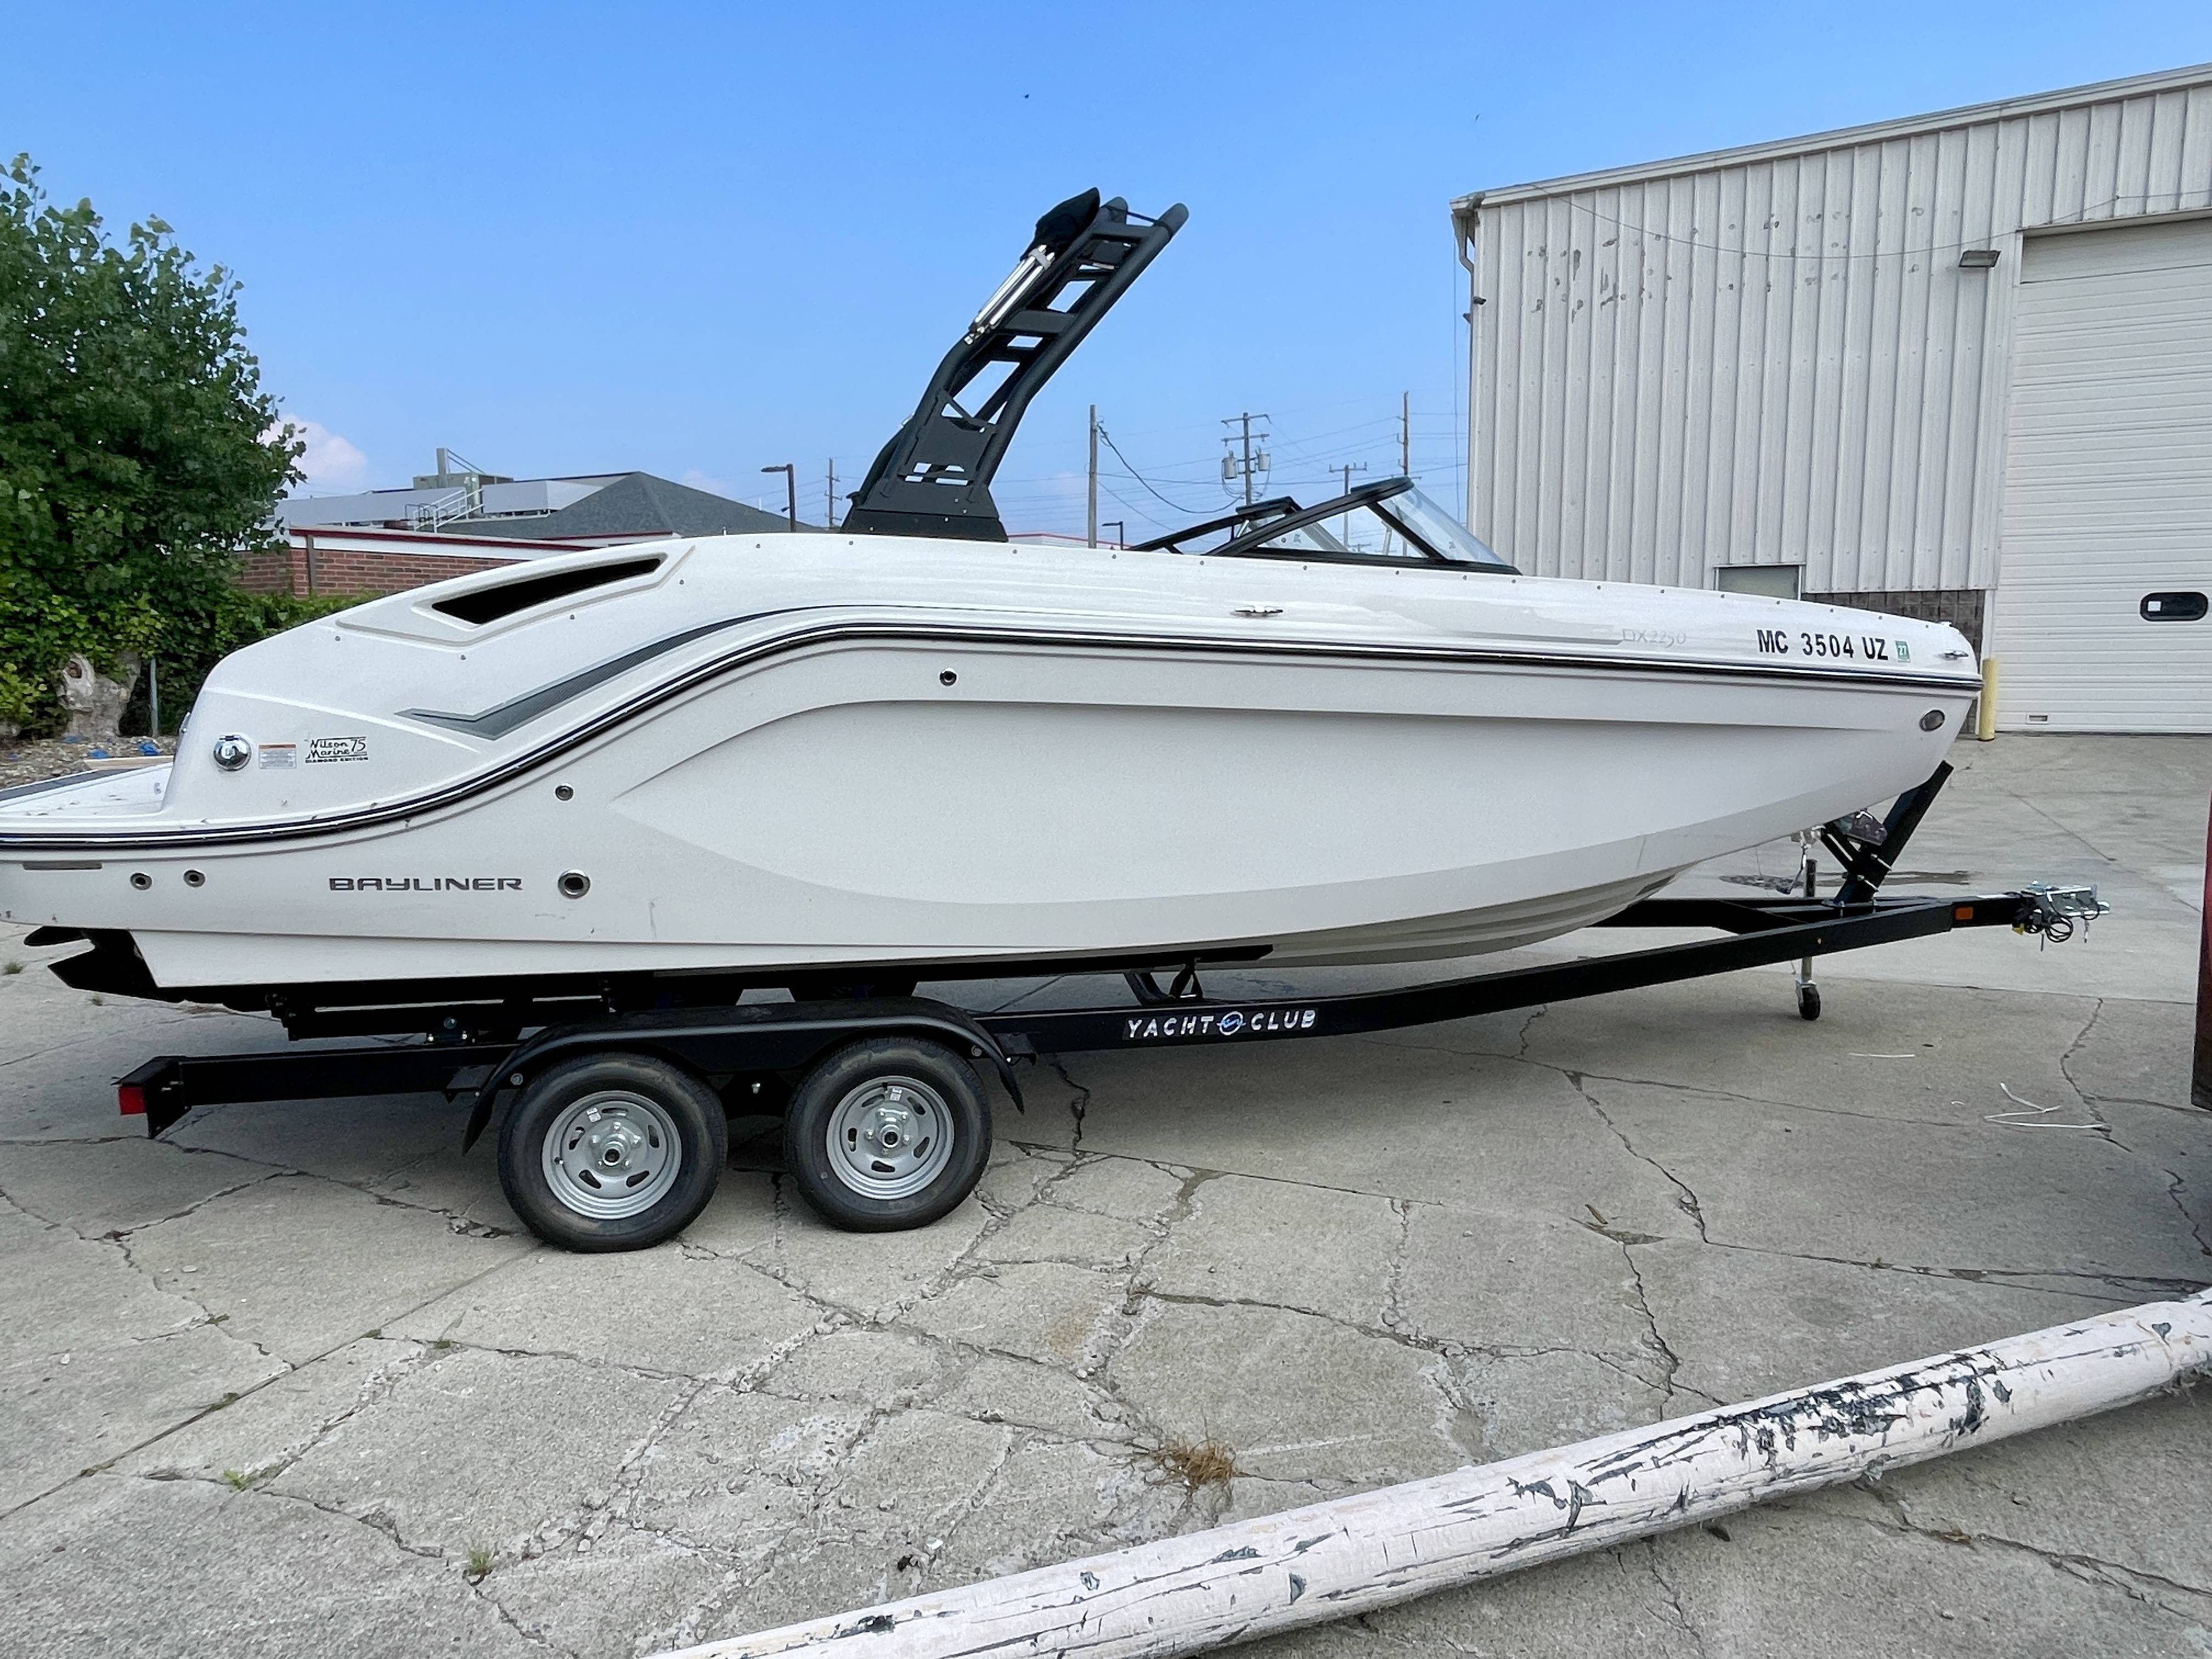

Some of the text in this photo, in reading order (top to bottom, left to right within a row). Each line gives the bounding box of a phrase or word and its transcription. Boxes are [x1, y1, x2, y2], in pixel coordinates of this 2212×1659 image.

[1622, 628, 1687, 648] DX2250
[1757, 629, 1888, 660] MC 3504 UZ
[306, 748, 350, 759] Marine
[350, 738, 366, 752] 75
[329, 878, 523, 891] BAYLINER
[1128, 1009, 1316, 1038] YACHT CLUB
